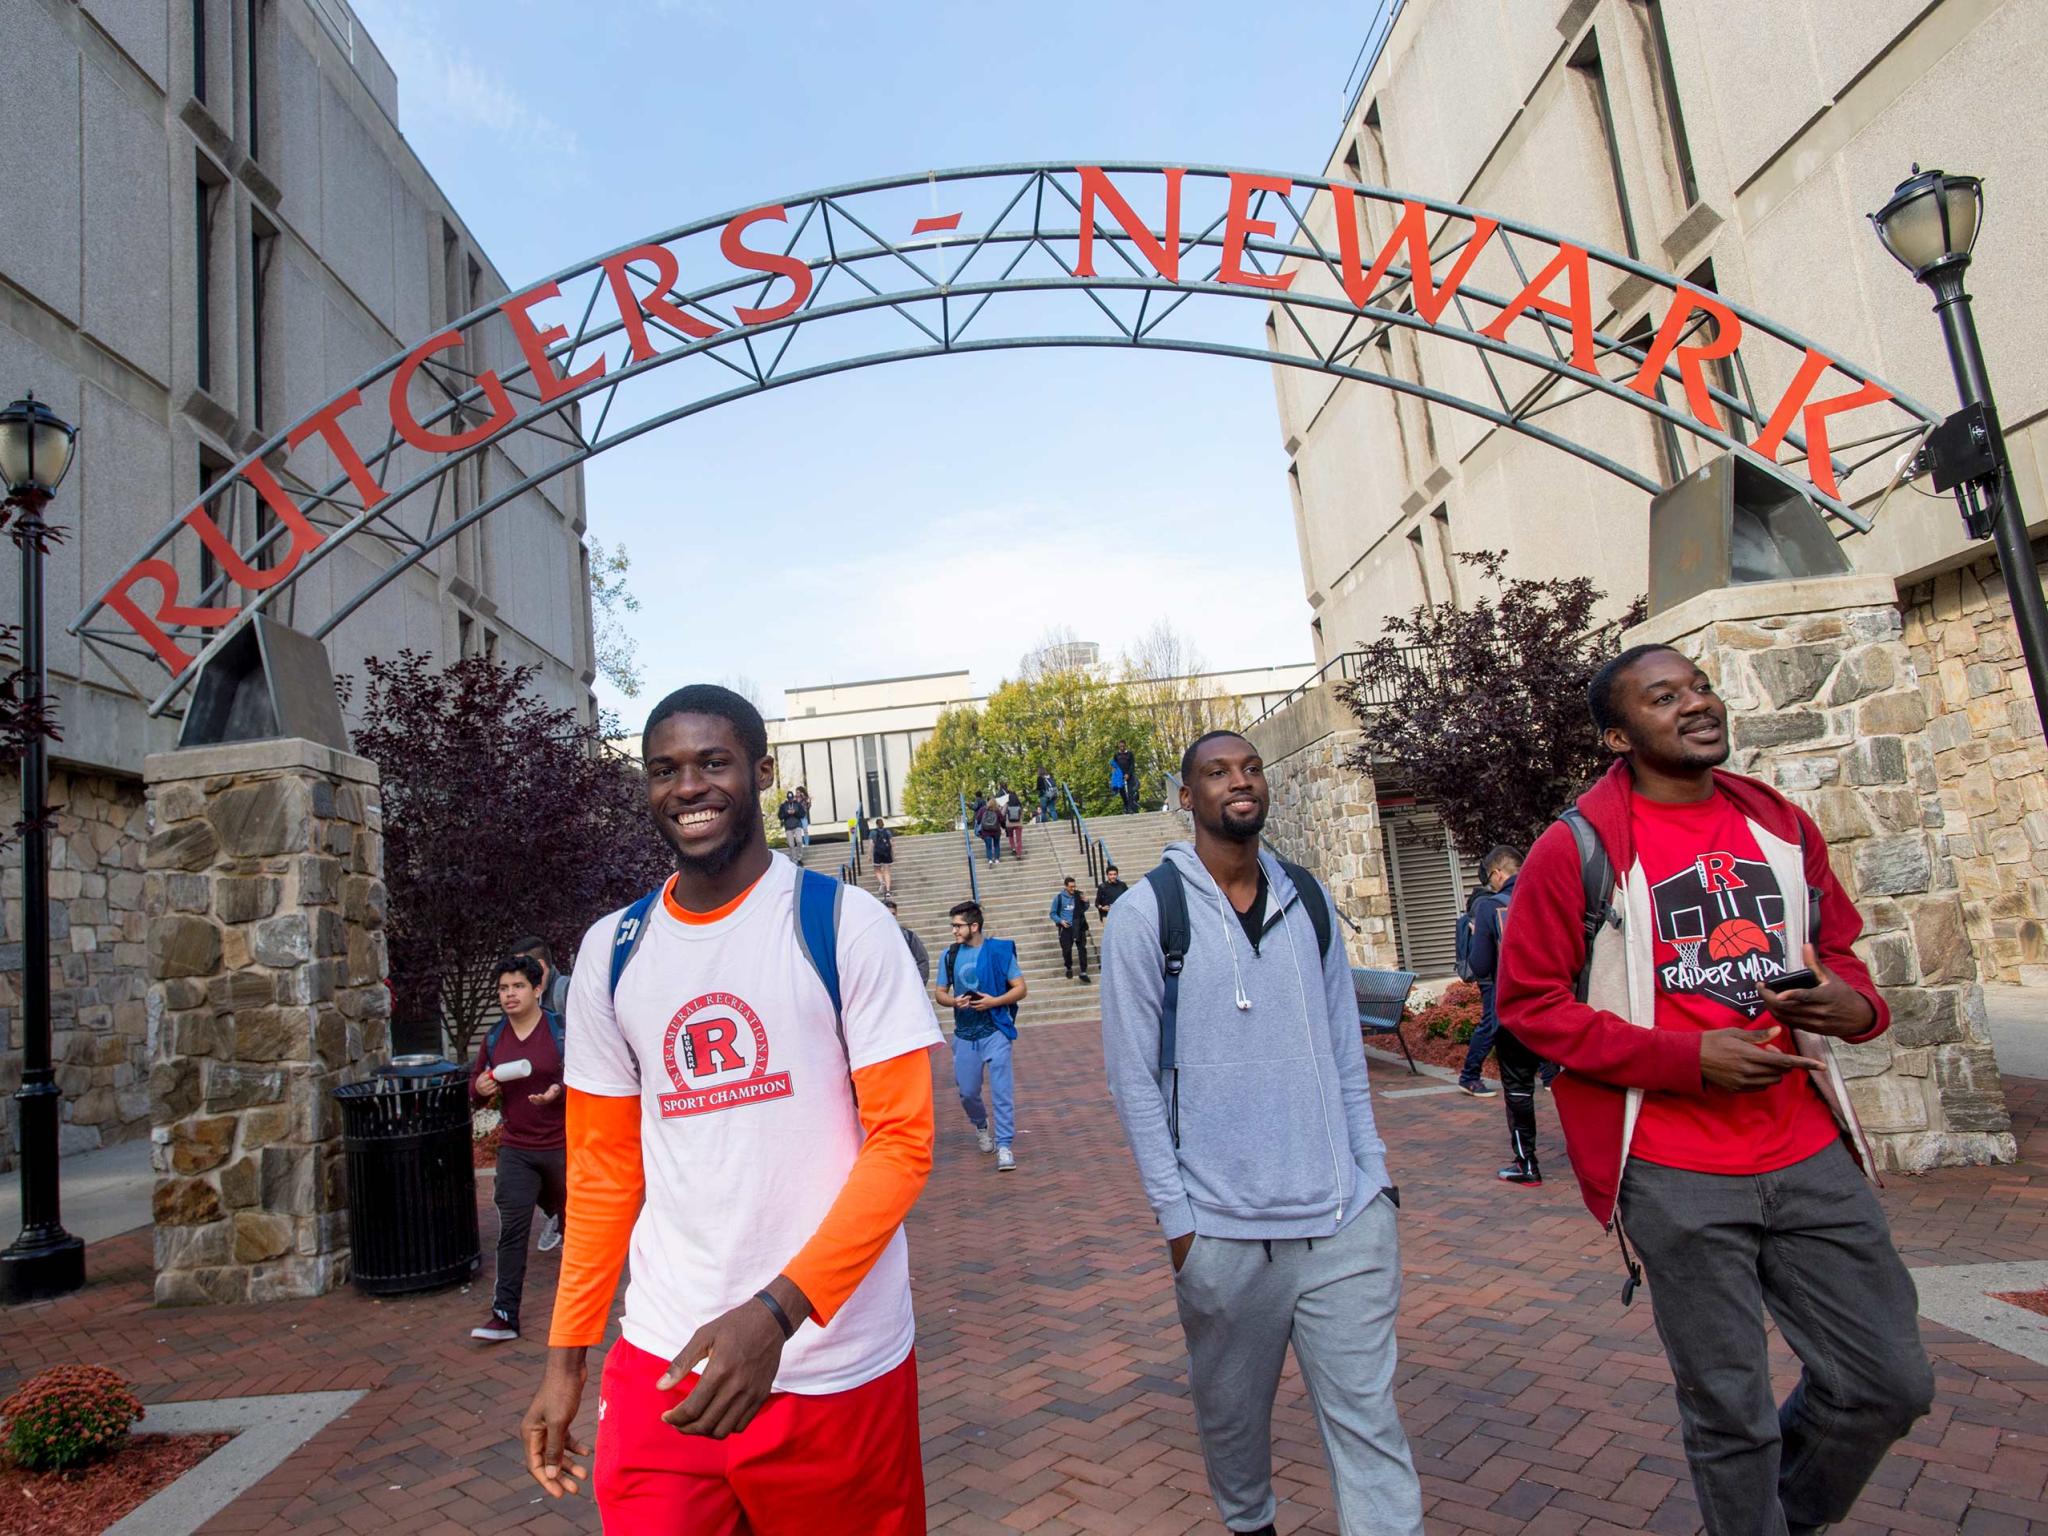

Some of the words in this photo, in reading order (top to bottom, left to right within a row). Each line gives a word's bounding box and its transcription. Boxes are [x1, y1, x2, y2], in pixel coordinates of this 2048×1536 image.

[105, 205, 812, 674] RUTGERS
[1071, 166, 1895, 501] NEWARK
[1697, 851, 1747, 893] R
[1662, 961, 1737, 989] RAIDER
[1737, 953, 1787, 982] MADN
[665, 1000, 702, 1089] INTRAMURAL
[706, 994, 767, 1073] RECREATIONAL
[683, 1034, 696, 1068] NEWARK
[686, 1017, 745, 1077] R
[663, 1096, 706, 1112] SPORT
[709, 1079, 787, 1105] CHAMPION
